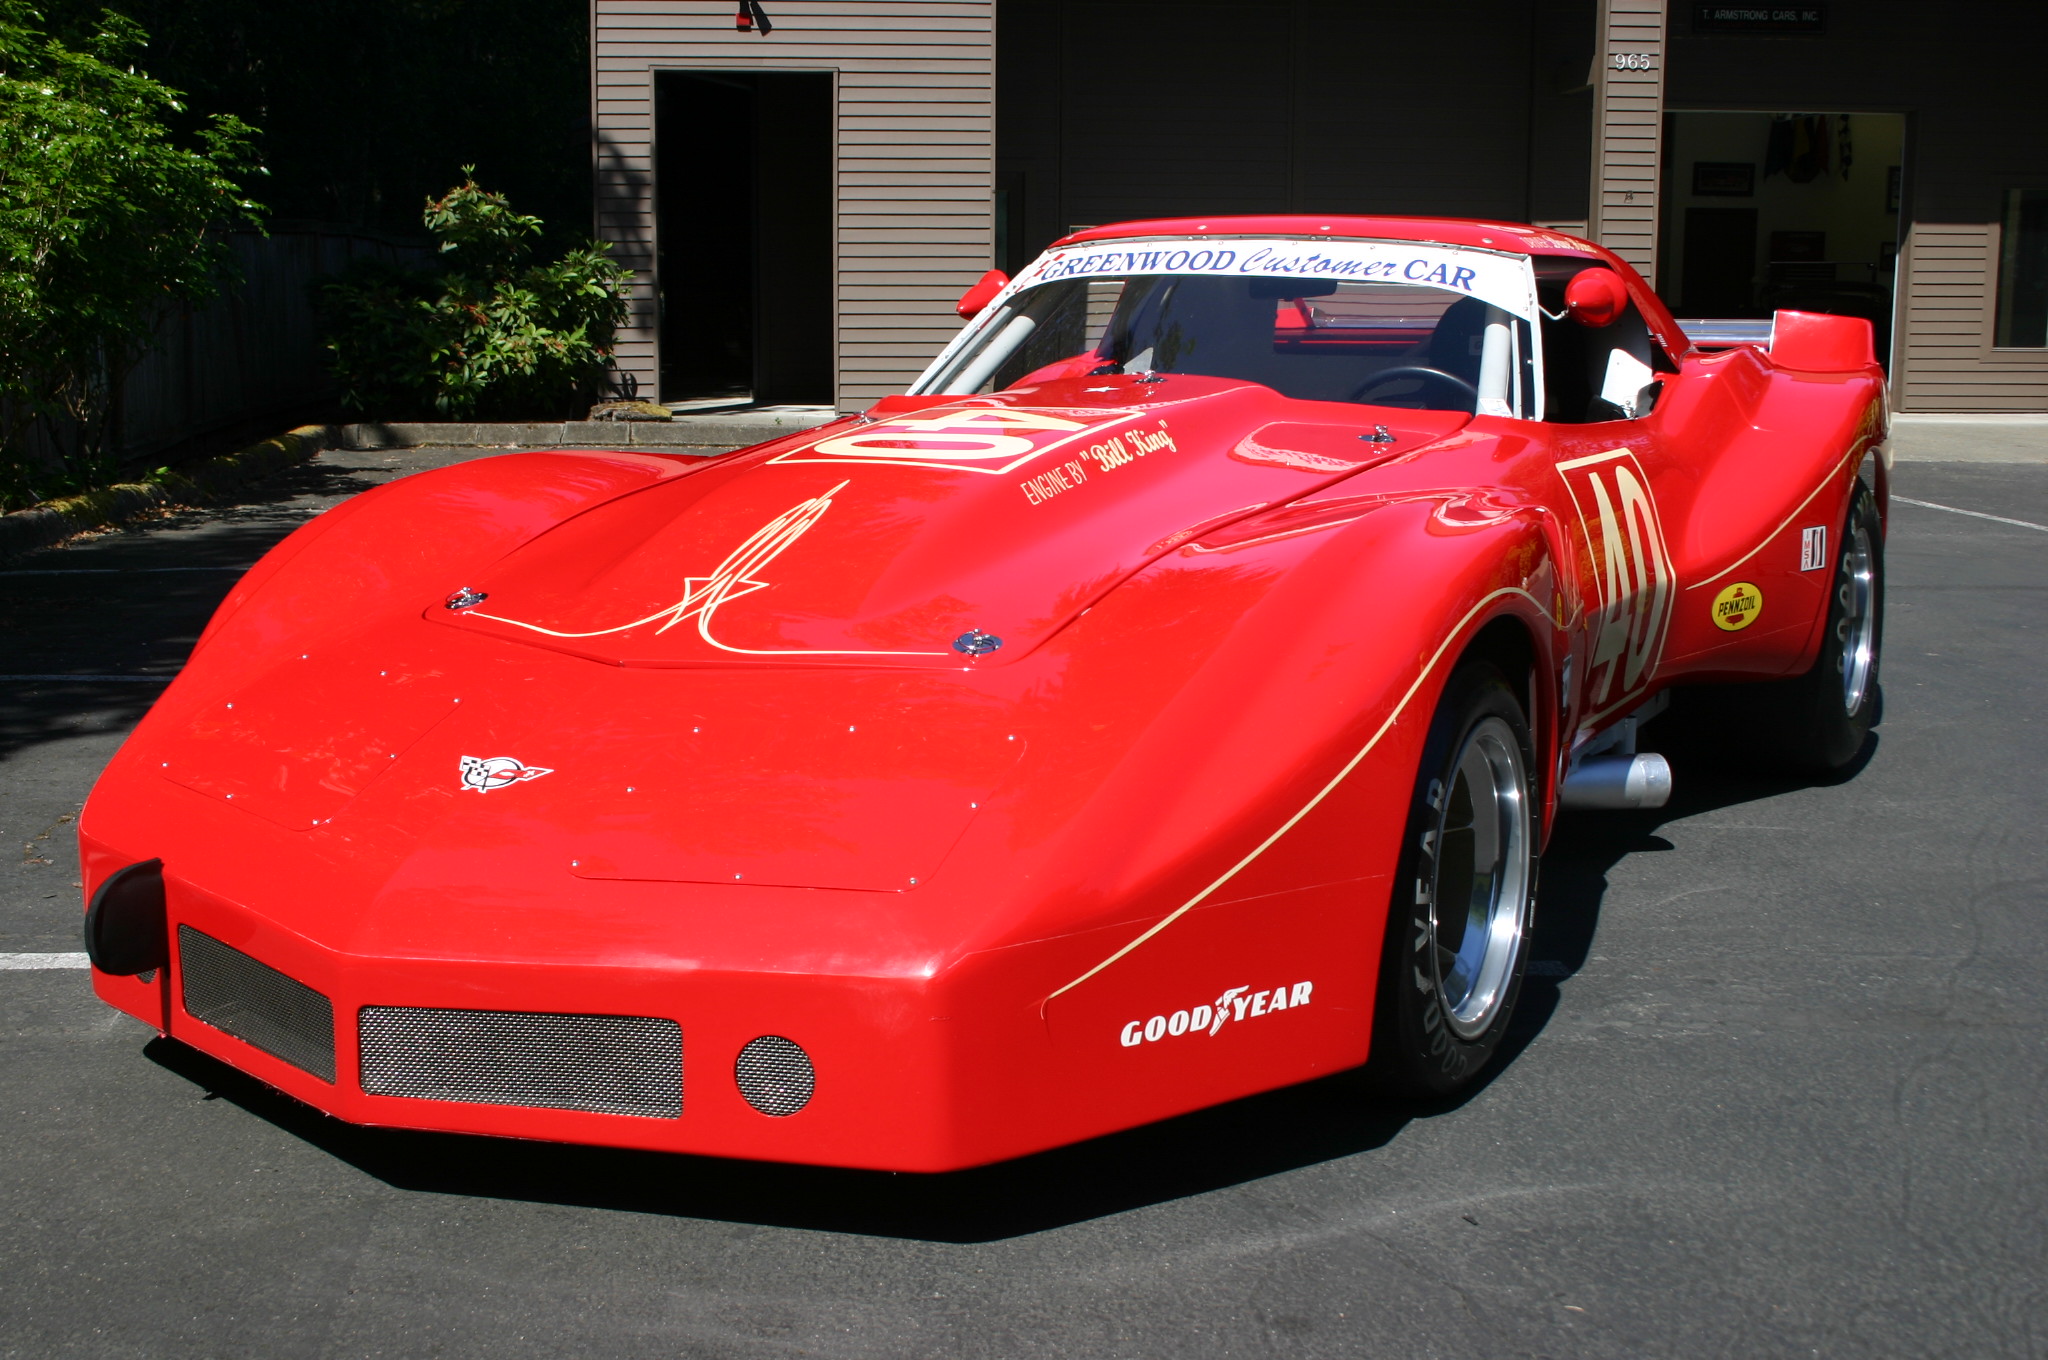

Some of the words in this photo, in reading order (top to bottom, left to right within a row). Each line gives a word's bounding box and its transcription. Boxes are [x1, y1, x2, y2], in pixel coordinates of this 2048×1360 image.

[1713, 9, 1769, 21] ARMSTRONG
[1615, 53, 1650, 70] 965
[1041, 250, 1236, 281] GREENWOOD
[1239, 247, 1398, 277] Customer
[1403, 259, 1476, 292] CAR
[1020, 466, 1074, 506] ENGINE
[1064, 459, 1088, 485] BY
[1588, 465, 1668, 705] 40
[1717, 595, 1756, 617] PENNZOIL
